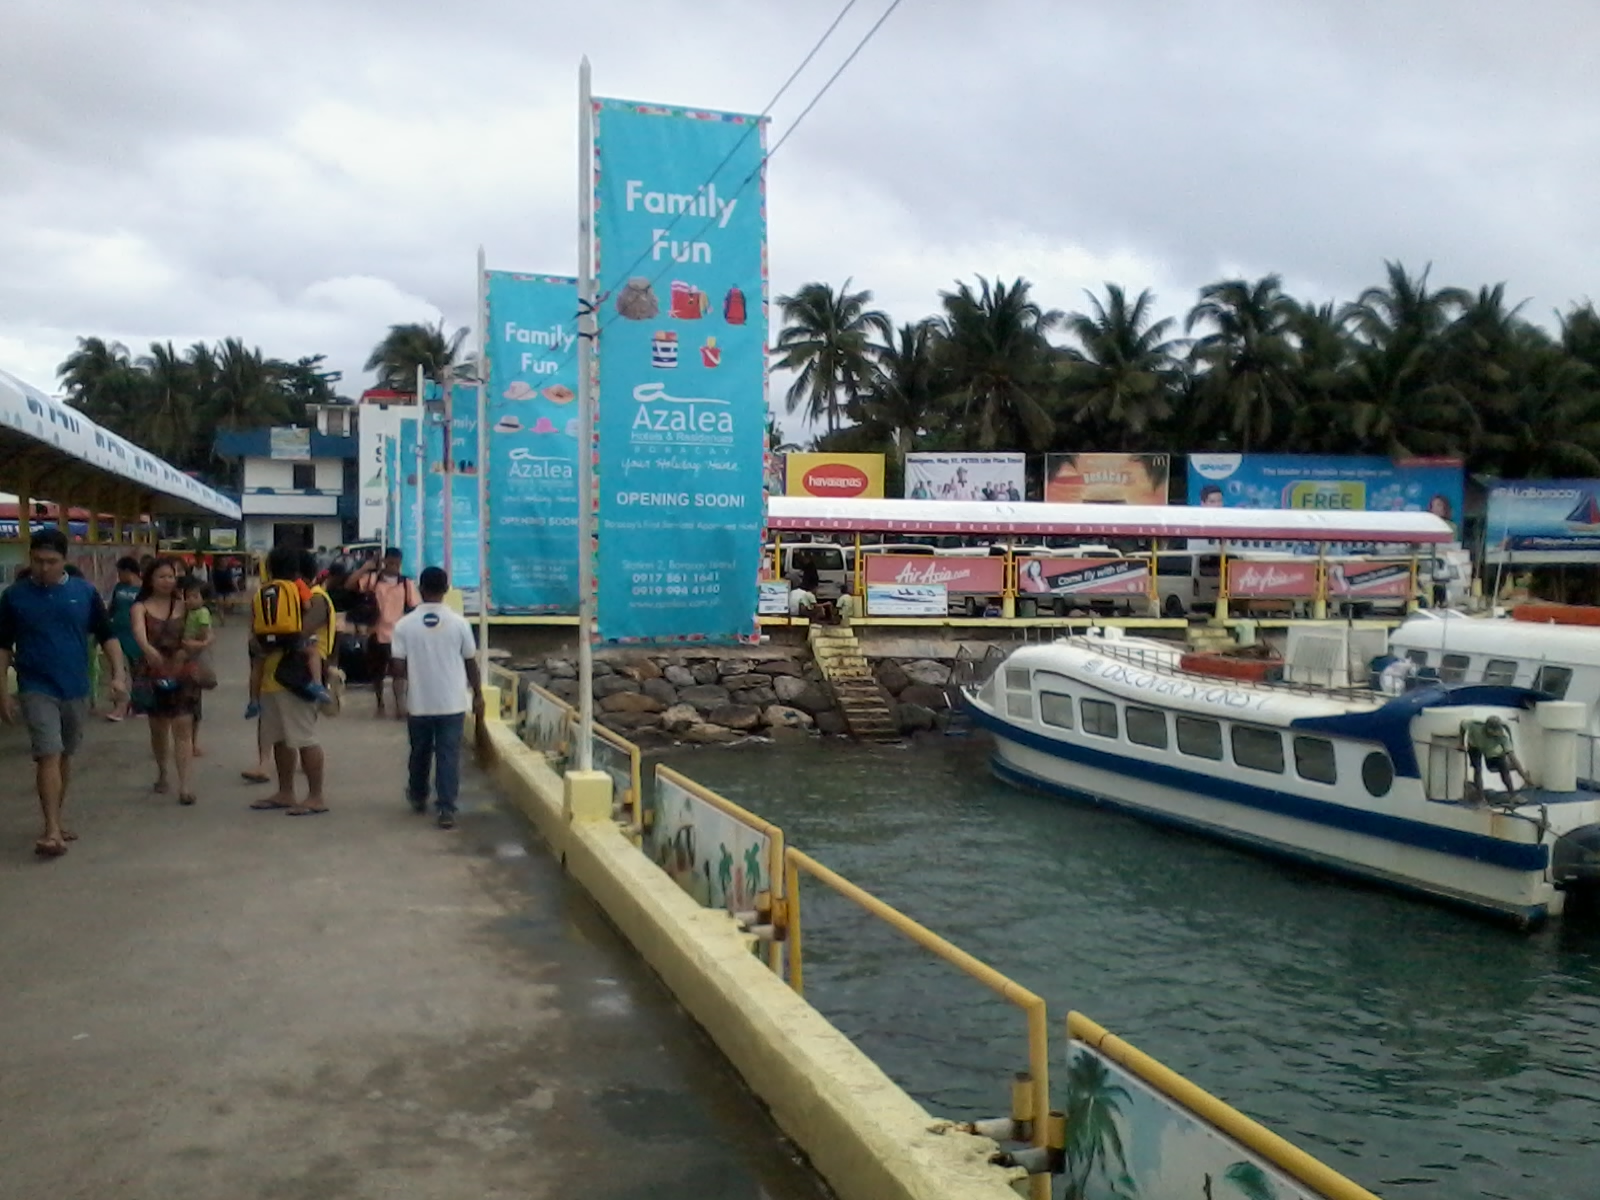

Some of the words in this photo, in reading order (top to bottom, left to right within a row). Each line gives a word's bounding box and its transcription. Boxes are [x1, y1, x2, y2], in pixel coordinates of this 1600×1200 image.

[626, 179, 737, 229] Family
[652, 228, 711, 264] Fun
[504, 321, 576, 354] Family
[521, 352, 559, 375] Fun
[631, 403, 734, 434] Azalea
[508, 460, 574, 479] Azalea
[807, 474, 864, 489] havaianas
[616, 491, 691, 507] OPENING
[693, 492, 746, 508] SOON!
[1302, 492, 1354, 510] FREE
[548, 516, 578, 527] SOON
[1057, 573, 1083, 586] Come
[1084, 569, 1096, 581] fly
[1096, 565, 1116, 578] with
